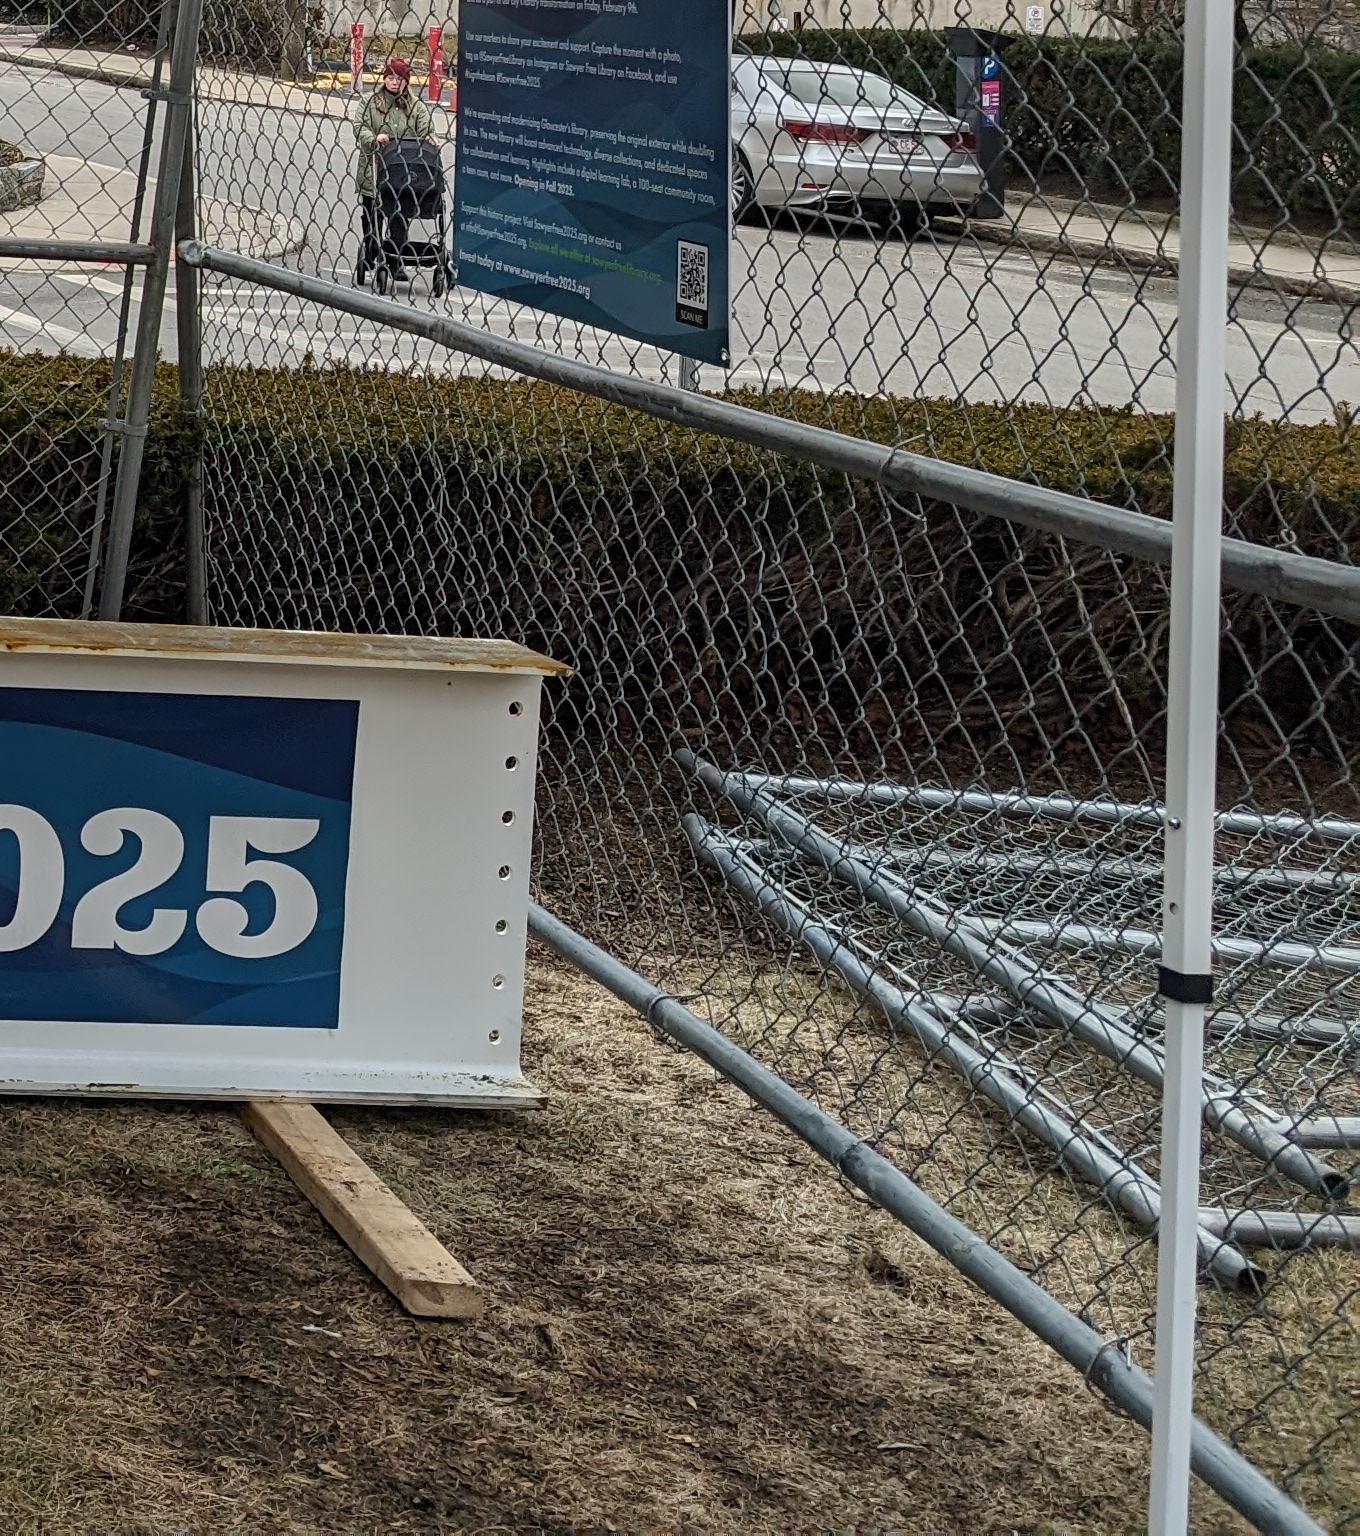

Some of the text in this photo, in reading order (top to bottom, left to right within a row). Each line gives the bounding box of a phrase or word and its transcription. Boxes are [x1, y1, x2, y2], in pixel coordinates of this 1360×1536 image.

[602, 0, 626, 15] February
[645, 47, 656, 59] with
[597, 63, 616, 79] Library
[626, 131, 647, 149] original
[648, 135, 670, 149] exterior
[671, 138, 686, 152] while
[687, 141, 714, 161] doubling
[644, 156, 655, 169] and
[656, 158, 685, 175] dedicated
[686, 167, 707, 182] spaces
[514, 174, 538, 191] Opening
[539, 179, 544, 190] in
[545, 180, 556, 192] Fall
[557, 182, 574, 196] 2025.
[598, 169, 619, 188] learning
[620, 173, 631, 190] lab,
[638, 176, 663, 193] 100-seat
[664, 181, 697, 203] community
[477, 252, 494, 272] today
[495, 257, 502, 270] at
[680, 309, 703, 324] SCAN ME
